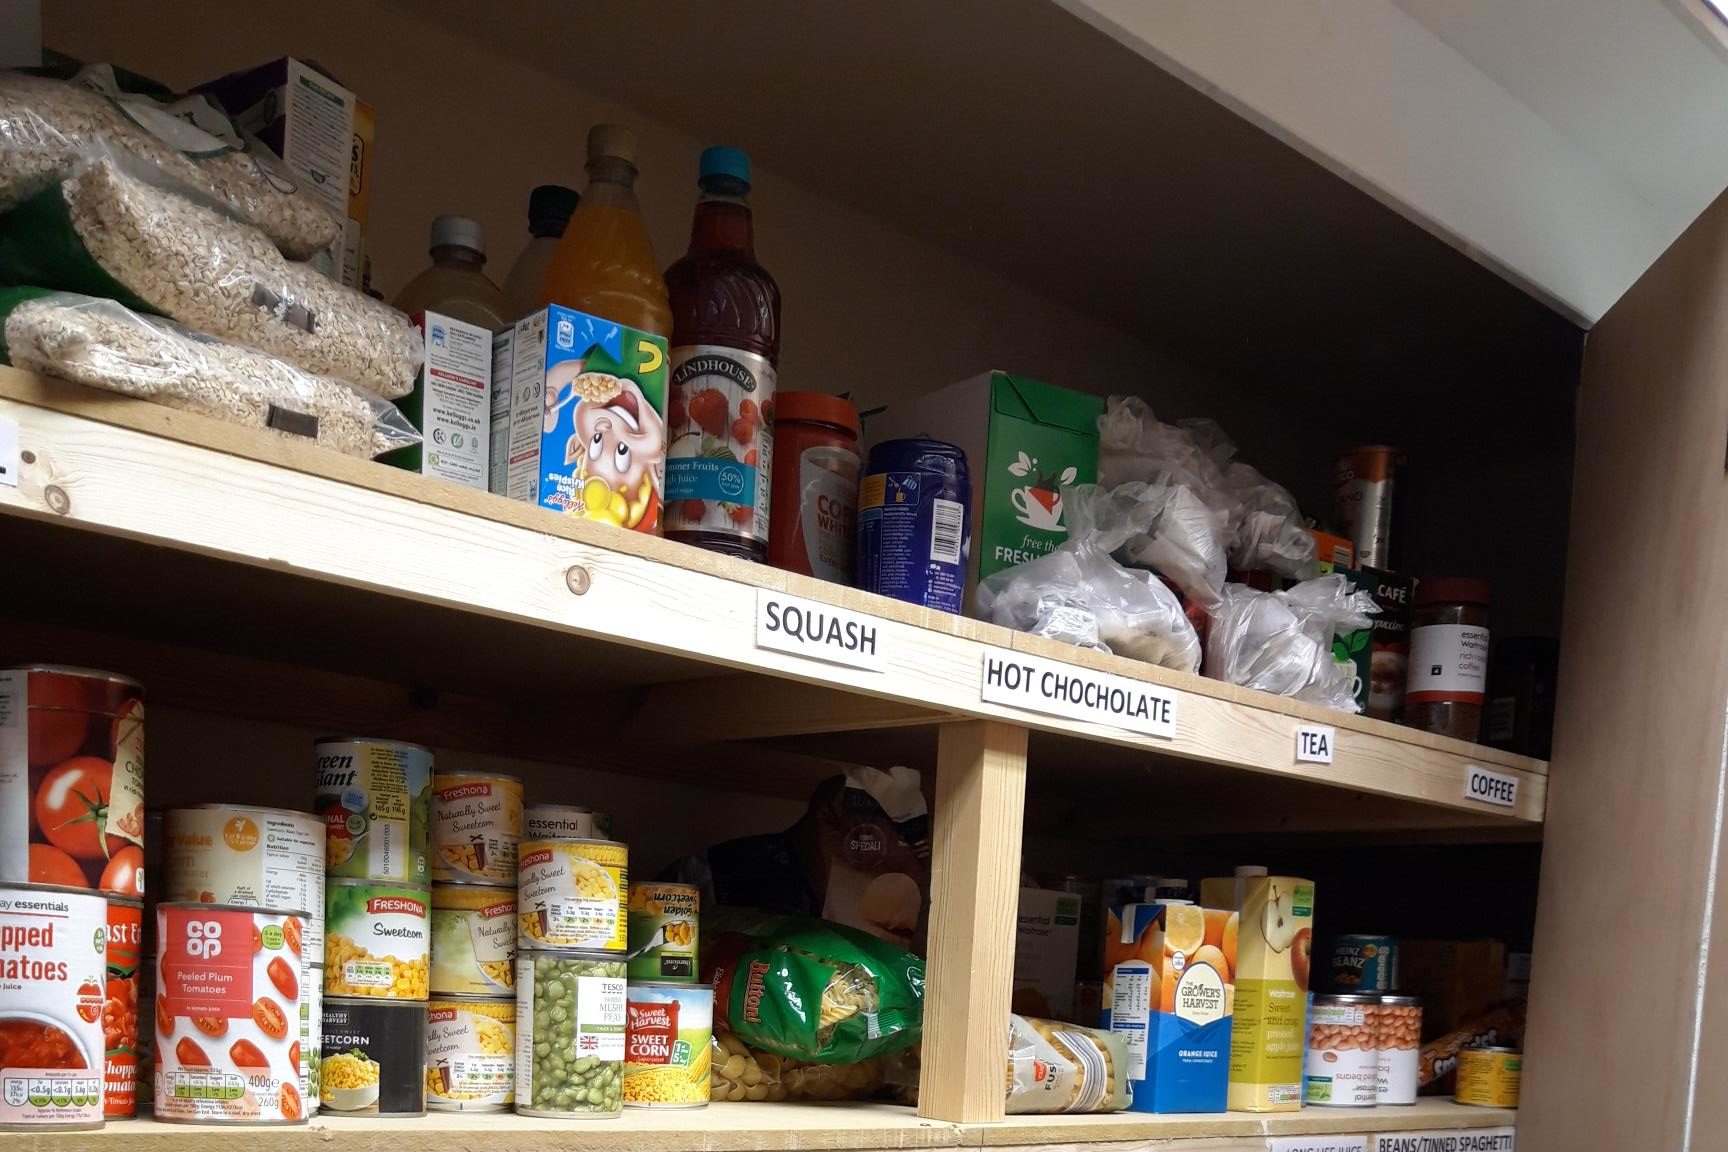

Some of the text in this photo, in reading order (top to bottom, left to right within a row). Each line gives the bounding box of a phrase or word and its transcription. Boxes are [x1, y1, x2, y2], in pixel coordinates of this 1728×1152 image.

[675, 360, 753, 389] LINDHOUSE
[693, 462, 719, 472] Fruits
[546, 472, 585, 489] Krispies
[720, 471, 742, 485] 50%
[556, 482, 576, 497] Rice
[1021, 534, 1042, 551] free
[766, 601, 877, 656] SQUASH
[987, 657, 1171, 724] HOT CHOCHOLATE
[1301, 731, 1328, 757] TEA
[317, 770, 355, 787] iant
[444, 785, 488, 801] Freshona
[1471, 772, 1515, 803] COFFEE
[437, 802, 501, 822] Naturally Sweet
[453, 819, 494, 833] Sweetcorn
[528, 819, 578, 831] essential
[541, 866, 566, 881] Sweet
[15, 902, 69, 912] essentials
[373, 899, 424, 915] FRESHONA
[0, 922, 54, 948] pped
[373, 922, 424, 939] Sweetcorn
[177, 971, 233, 982] Peeled Plum
[183, 984, 227, 995] Tomatoes
[602, 983, 624, 991] TESCO
[1181, 984, 1221, 998] GROWER'S
[1183, 998, 1219, 1010] HARVEST
[638, 1007, 667, 1019] Sweet
[631, 1015, 672, 1029] Harvest
[443, 1025, 469, 1039] Sweet
[322, 1034, 370, 1046] EETCORN
[631, 1035, 669, 1045] SWEET
[630, 1045, 670, 1056] CORN
[1179, 1050, 1218, 1058] ORANGE JUICE
[258, 1096, 279, 1109] 260g
[1458, 1135, 1512, 1152] SPAGHETTI
